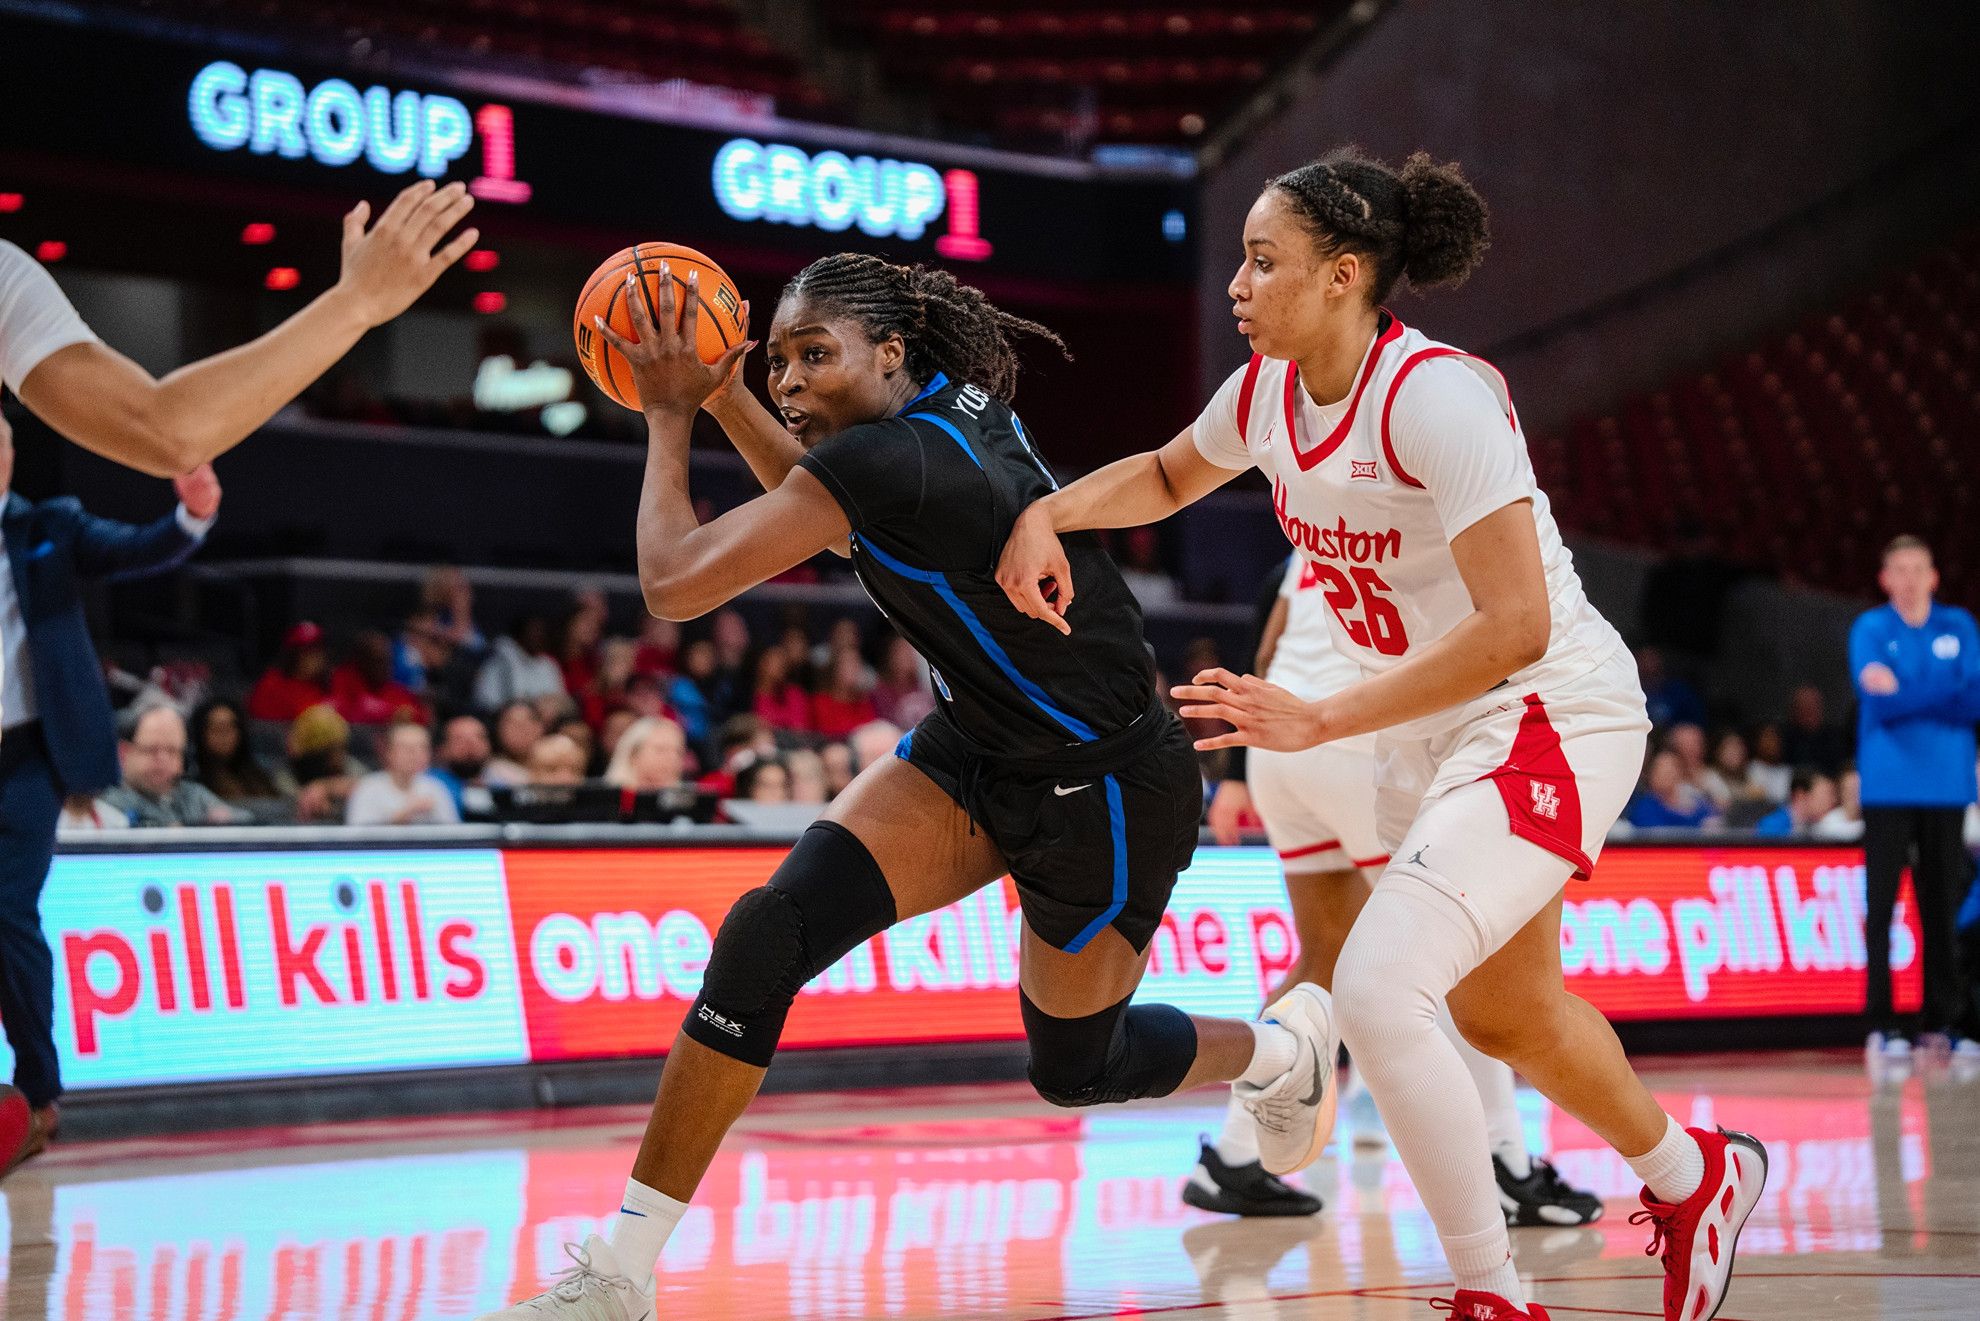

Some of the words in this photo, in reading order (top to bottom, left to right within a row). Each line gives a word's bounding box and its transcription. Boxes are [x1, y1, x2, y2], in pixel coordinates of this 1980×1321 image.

[951, 383, 990, 420] YUS
[1274, 473, 1402, 564] Houston
[1311, 560, 1409, 657] 26
[62, 881, 248, 1057] pill
[264, 879, 488, 1008] kills
[530, 908, 713, 1001] one
[882, 874, 1021, 992] kill
[1150, 906, 1234, 977] ne
[1562, 898, 1671, 977] one
[1673, 865, 1784, 1002] pill
[701, 1003, 743, 1031] HEX
